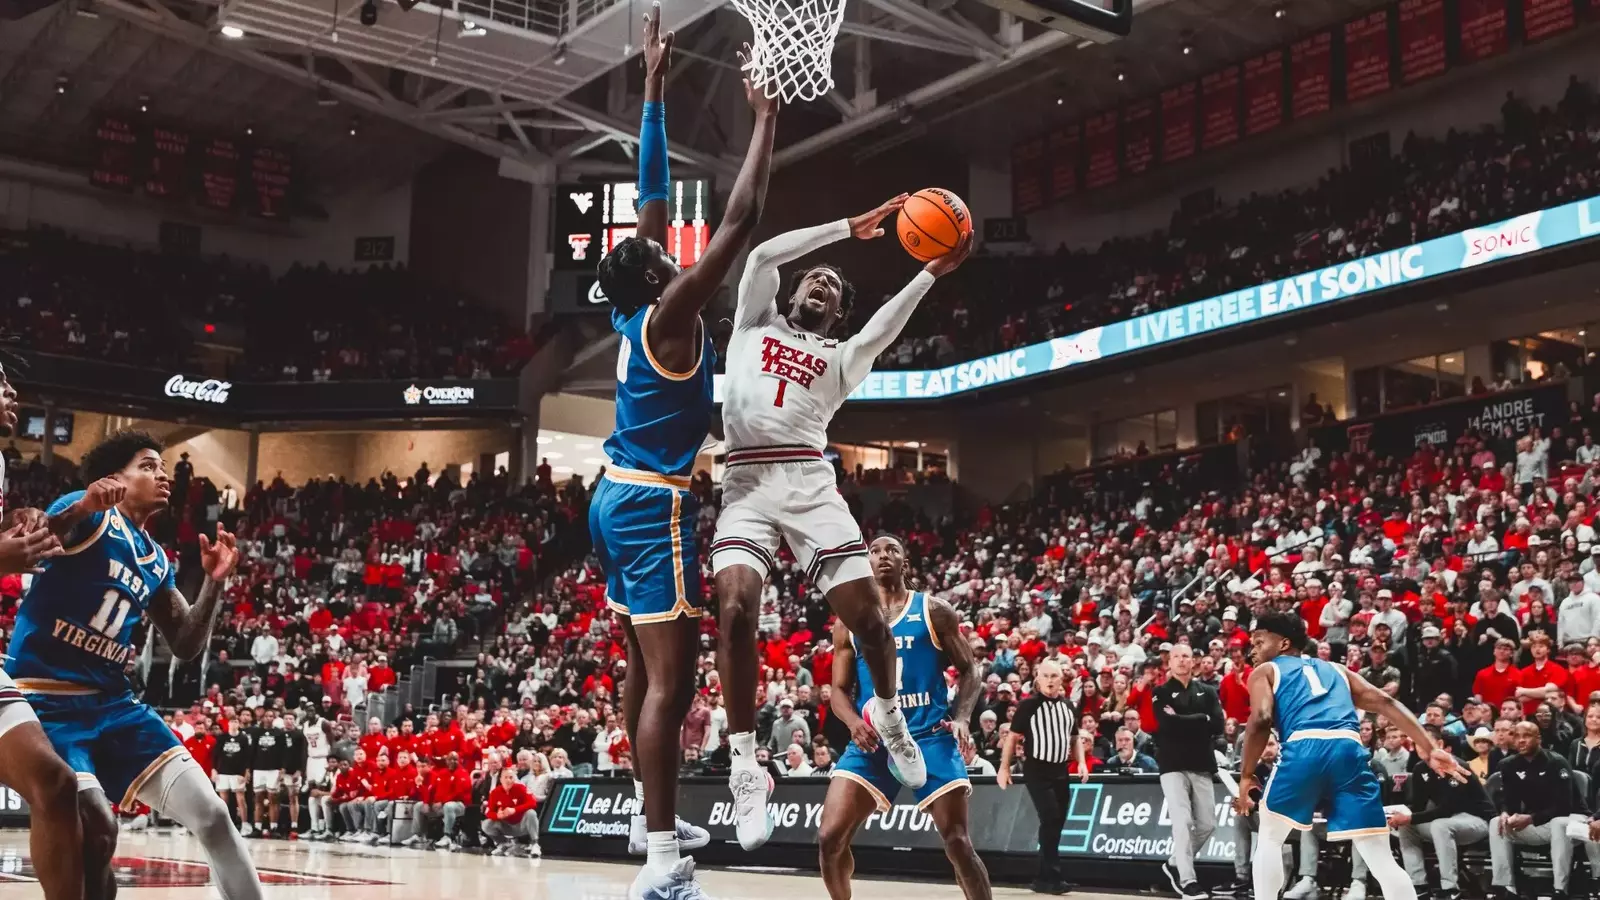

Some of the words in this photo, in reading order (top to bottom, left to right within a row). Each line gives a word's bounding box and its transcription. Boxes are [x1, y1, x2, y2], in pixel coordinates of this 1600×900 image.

[1472, 226, 1530, 256] SONIC
[1125, 309, 1186, 347] LIVE
[1188, 287, 1258, 333] FREE
[1260, 273, 1318, 317] EAT
[1321, 247, 1425, 300] SONIC
[761, 336, 828, 377] TEXAS
[761, 352, 815, 391] TECH
[905, 366, 956, 398] EAT
[956, 348, 1027, 390] SONIC
[773, 379, 788, 408] 1
[1482, 398, 1534, 422] ANDRE
[107, 558, 151, 603] WEST
[88, 588, 132, 640] 11
[51, 617, 130, 665] VIRGINIA
[895, 635, 915, 650] ST
[1302, 665, 1329, 697] 1
[895, 691, 931, 709] GINIA
[582, 792, 612, 814] Lee
[611, 792, 641, 815] Lew
[1099, 795, 1152, 826] Lee
